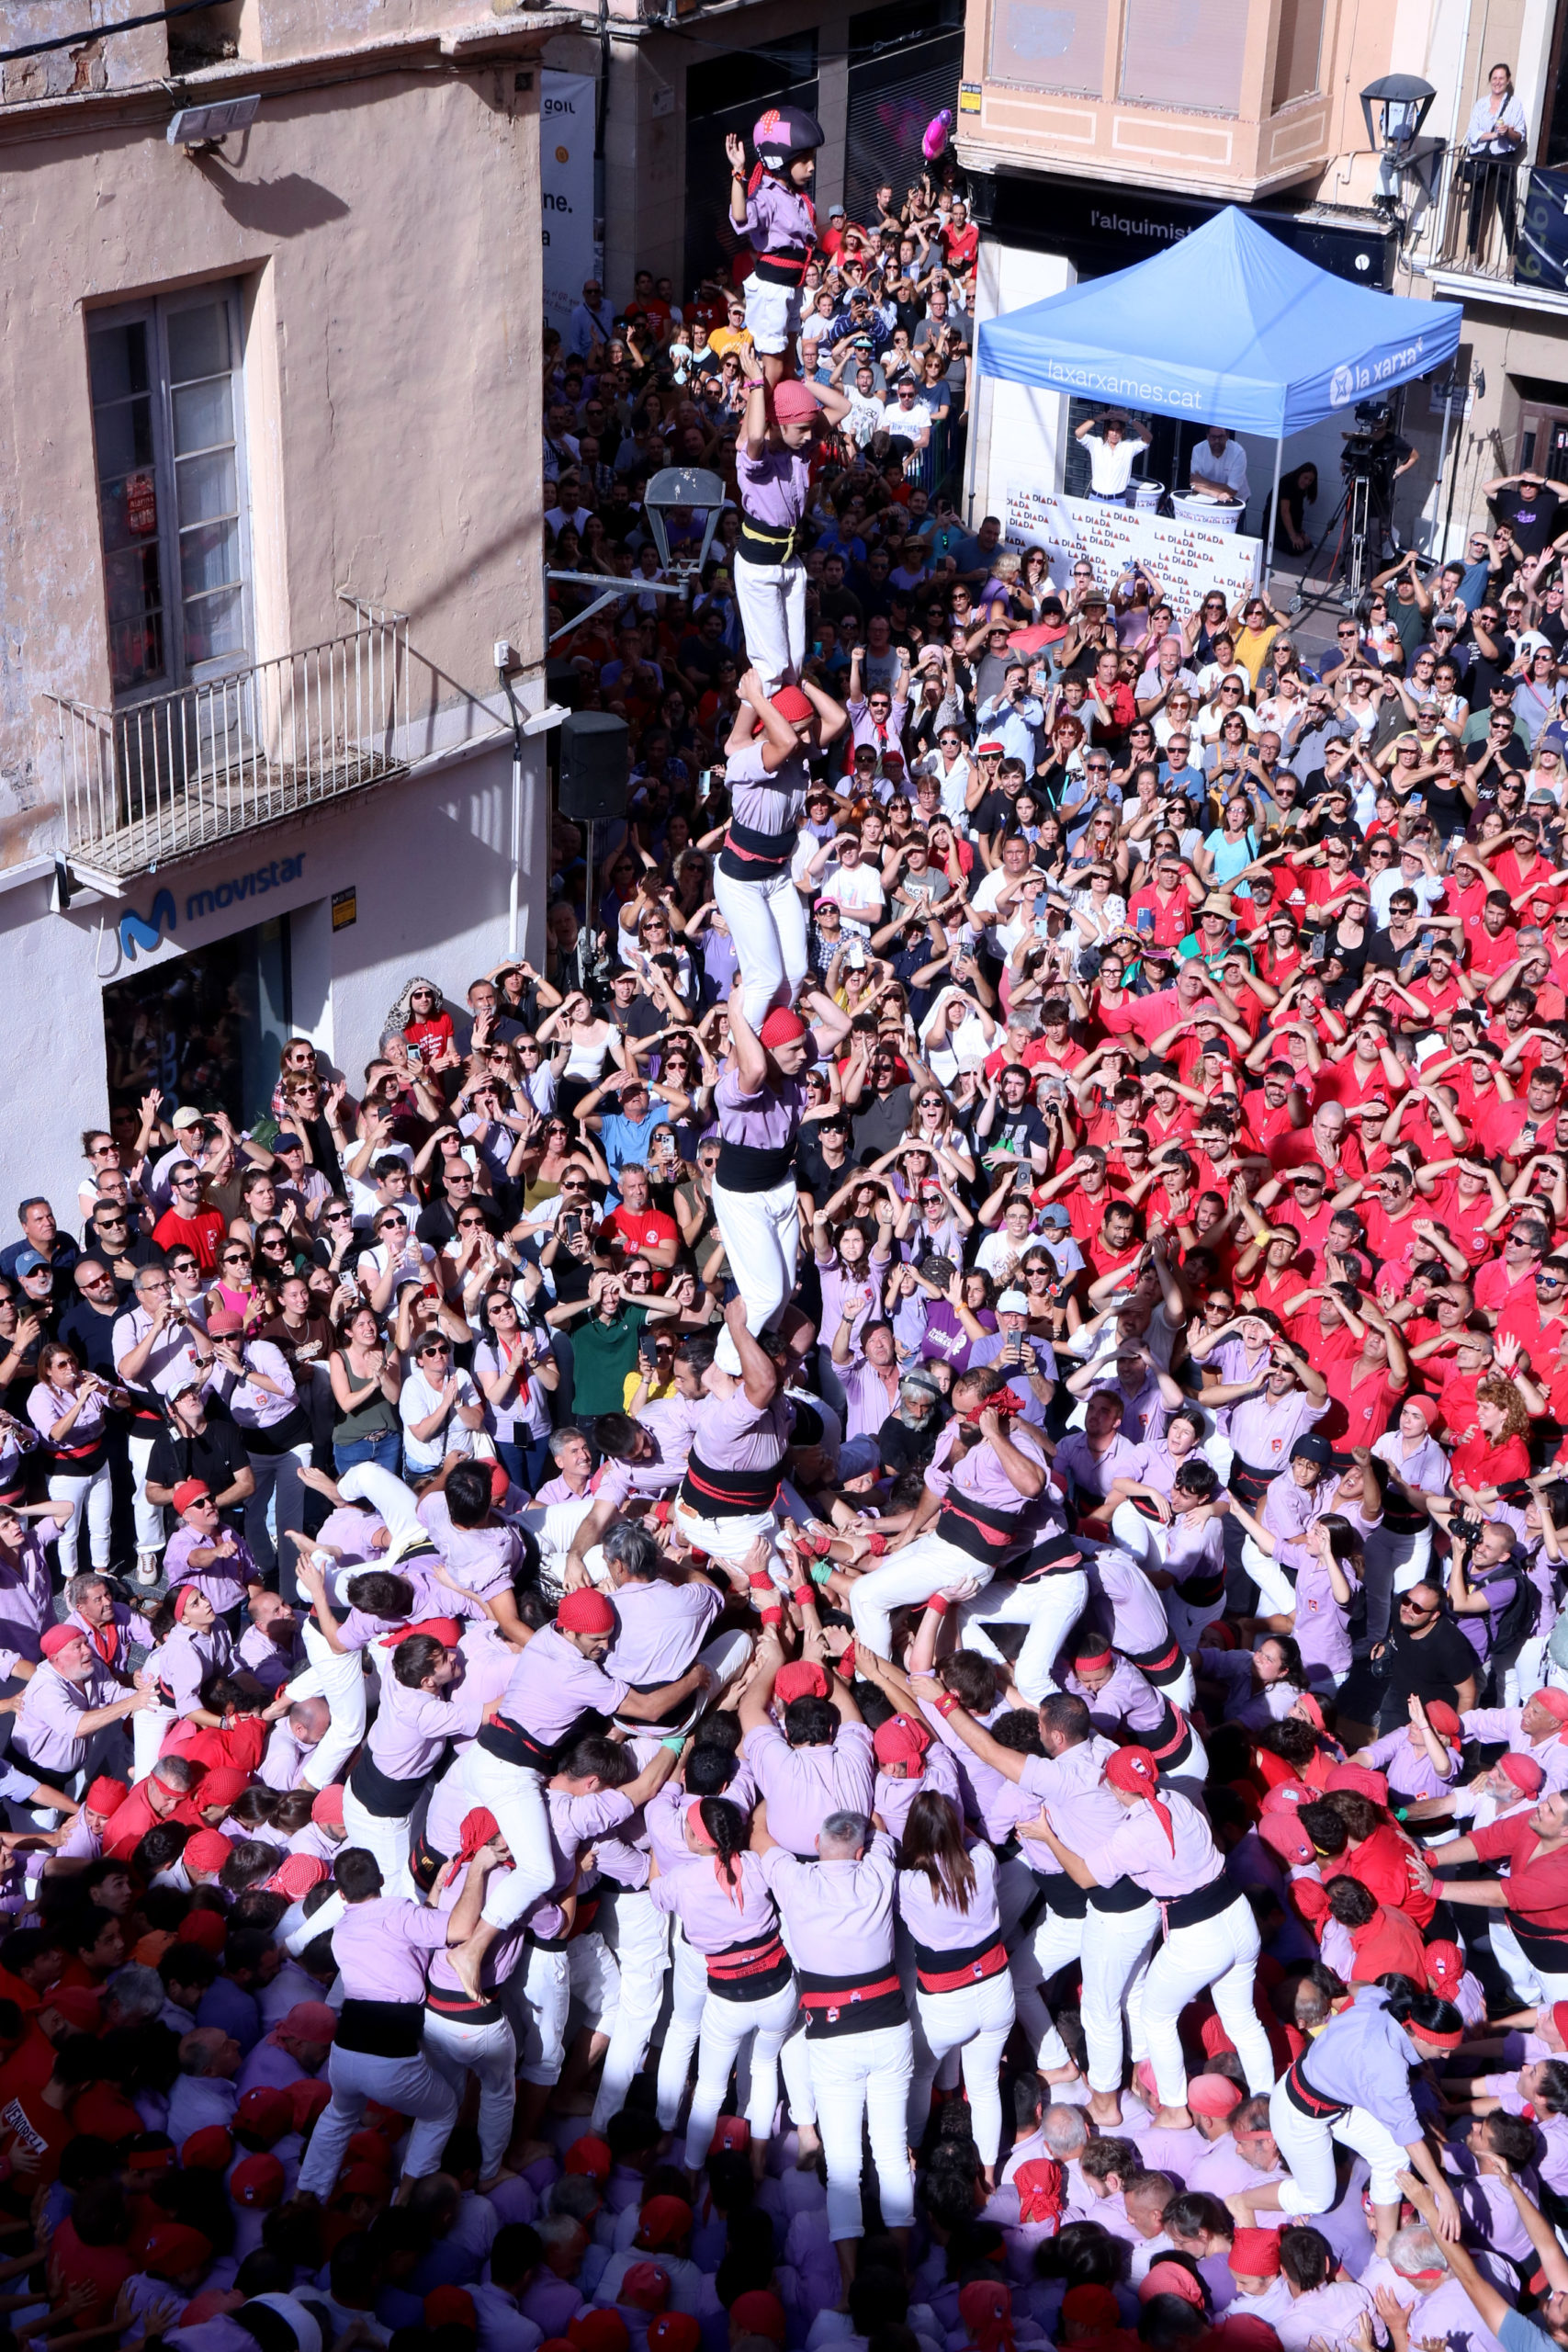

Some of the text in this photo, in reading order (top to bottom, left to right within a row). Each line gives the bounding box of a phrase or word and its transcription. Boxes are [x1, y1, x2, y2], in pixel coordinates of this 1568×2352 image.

[1048, 358, 1201, 410] laxarxames.cat
[1355, 366, 1370, 392] la
[1032, 494, 1058, 506] DIADA
[1010, 517, 1034, 529] DIADA
[1024, 512, 1049, 524] DIADA
[1086, 515, 1111, 527] DIADA
[1113, 512, 1139, 525] DIADA
[1089, 536, 1115, 548] DIADA
[1105, 530, 1130, 542] DIADA
[1168, 536, 1194, 548] DIADA
[1198, 532, 1224, 545] DIADA
[1062, 539, 1087, 551] DIADA
[1188, 549, 1213, 562] DIADA
[1143, 559, 1168, 571] DIADA
[1172, 556, 1198, 568] DIADA
[1163, 573, 1189, 585] DIADA
[1164, 593, 1190, 605] DIADA
[186, 852, 306, 921] movistar
